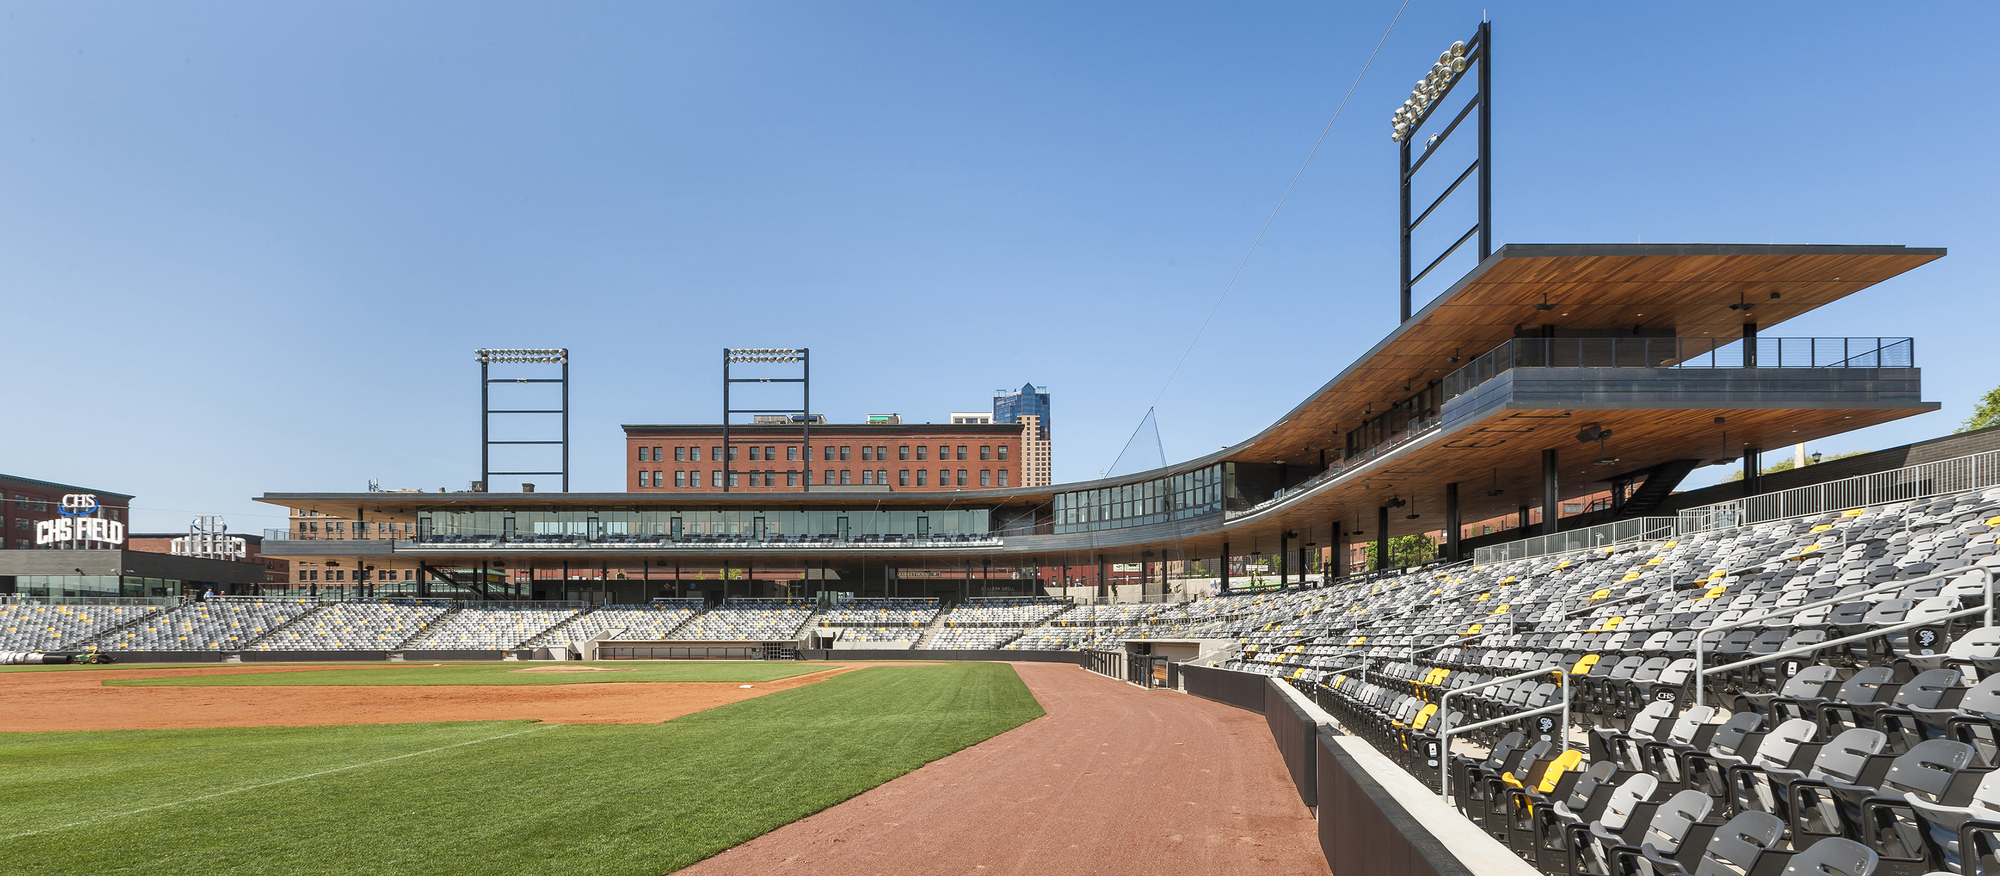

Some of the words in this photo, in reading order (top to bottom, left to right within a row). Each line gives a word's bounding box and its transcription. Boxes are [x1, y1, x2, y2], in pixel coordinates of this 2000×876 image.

[62, 494, 96, 507] CHS
[36, 518, 72, 545] CHS
[76, 517, 124, 545] FIELD
